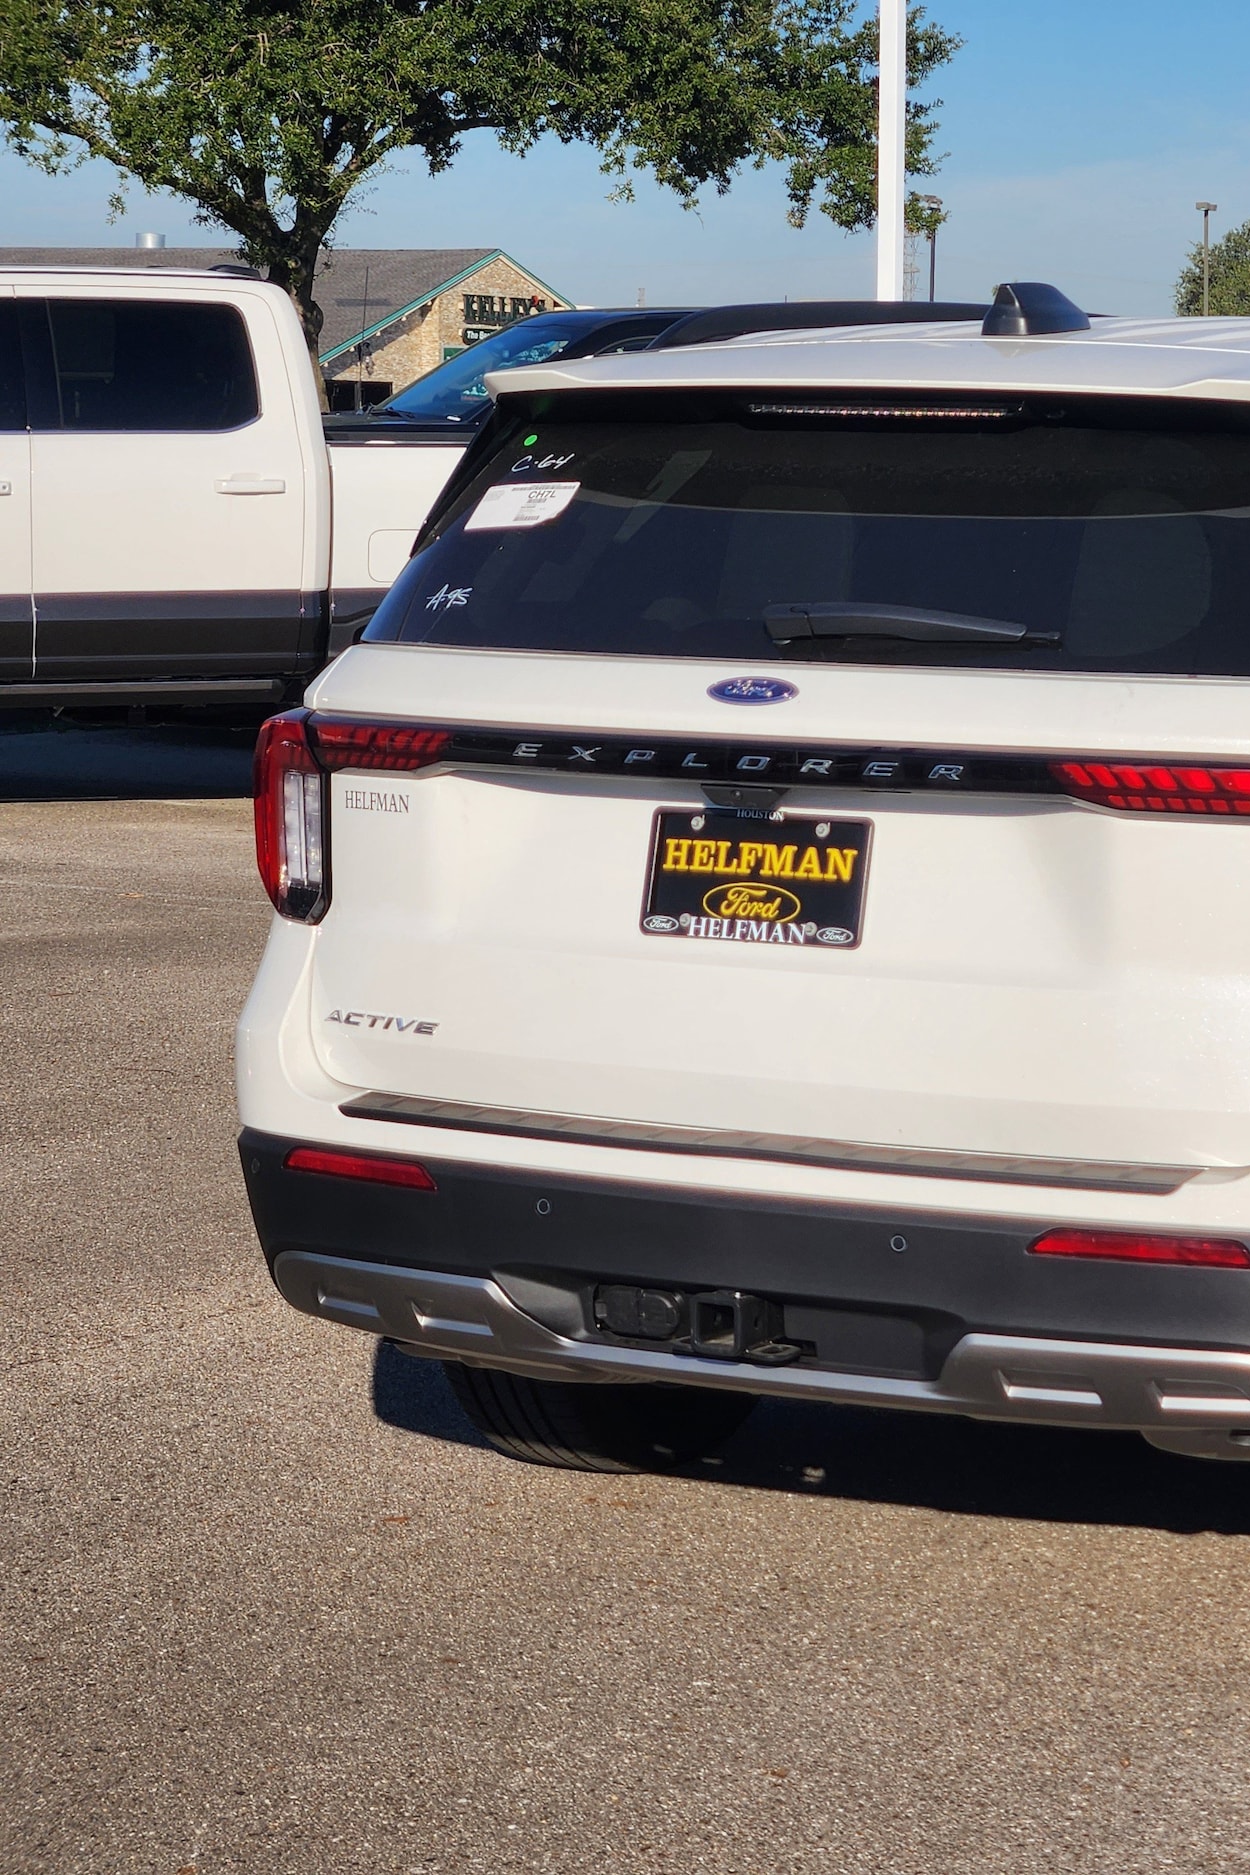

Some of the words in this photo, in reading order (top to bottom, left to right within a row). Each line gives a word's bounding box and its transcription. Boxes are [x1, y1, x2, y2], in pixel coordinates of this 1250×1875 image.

[466, 330, 479, 340] The
[528, 490, 557, 499] CH7L
[512, 743, 964, 782] EXPLORER
[345, 790, 409, 813] HELFMAN
[736, 808, 785, 822] HOUSTON
[662, 837, 858, 881] HELFMAN
[720, 886, 783, 918] Ford
[650, 917, 674, 930] Ford
[687, 917, 808, 944] HELFMAN
[823, 929, 847, 942] Ford
[323, 1009, 440, 1036] ACTIVE
